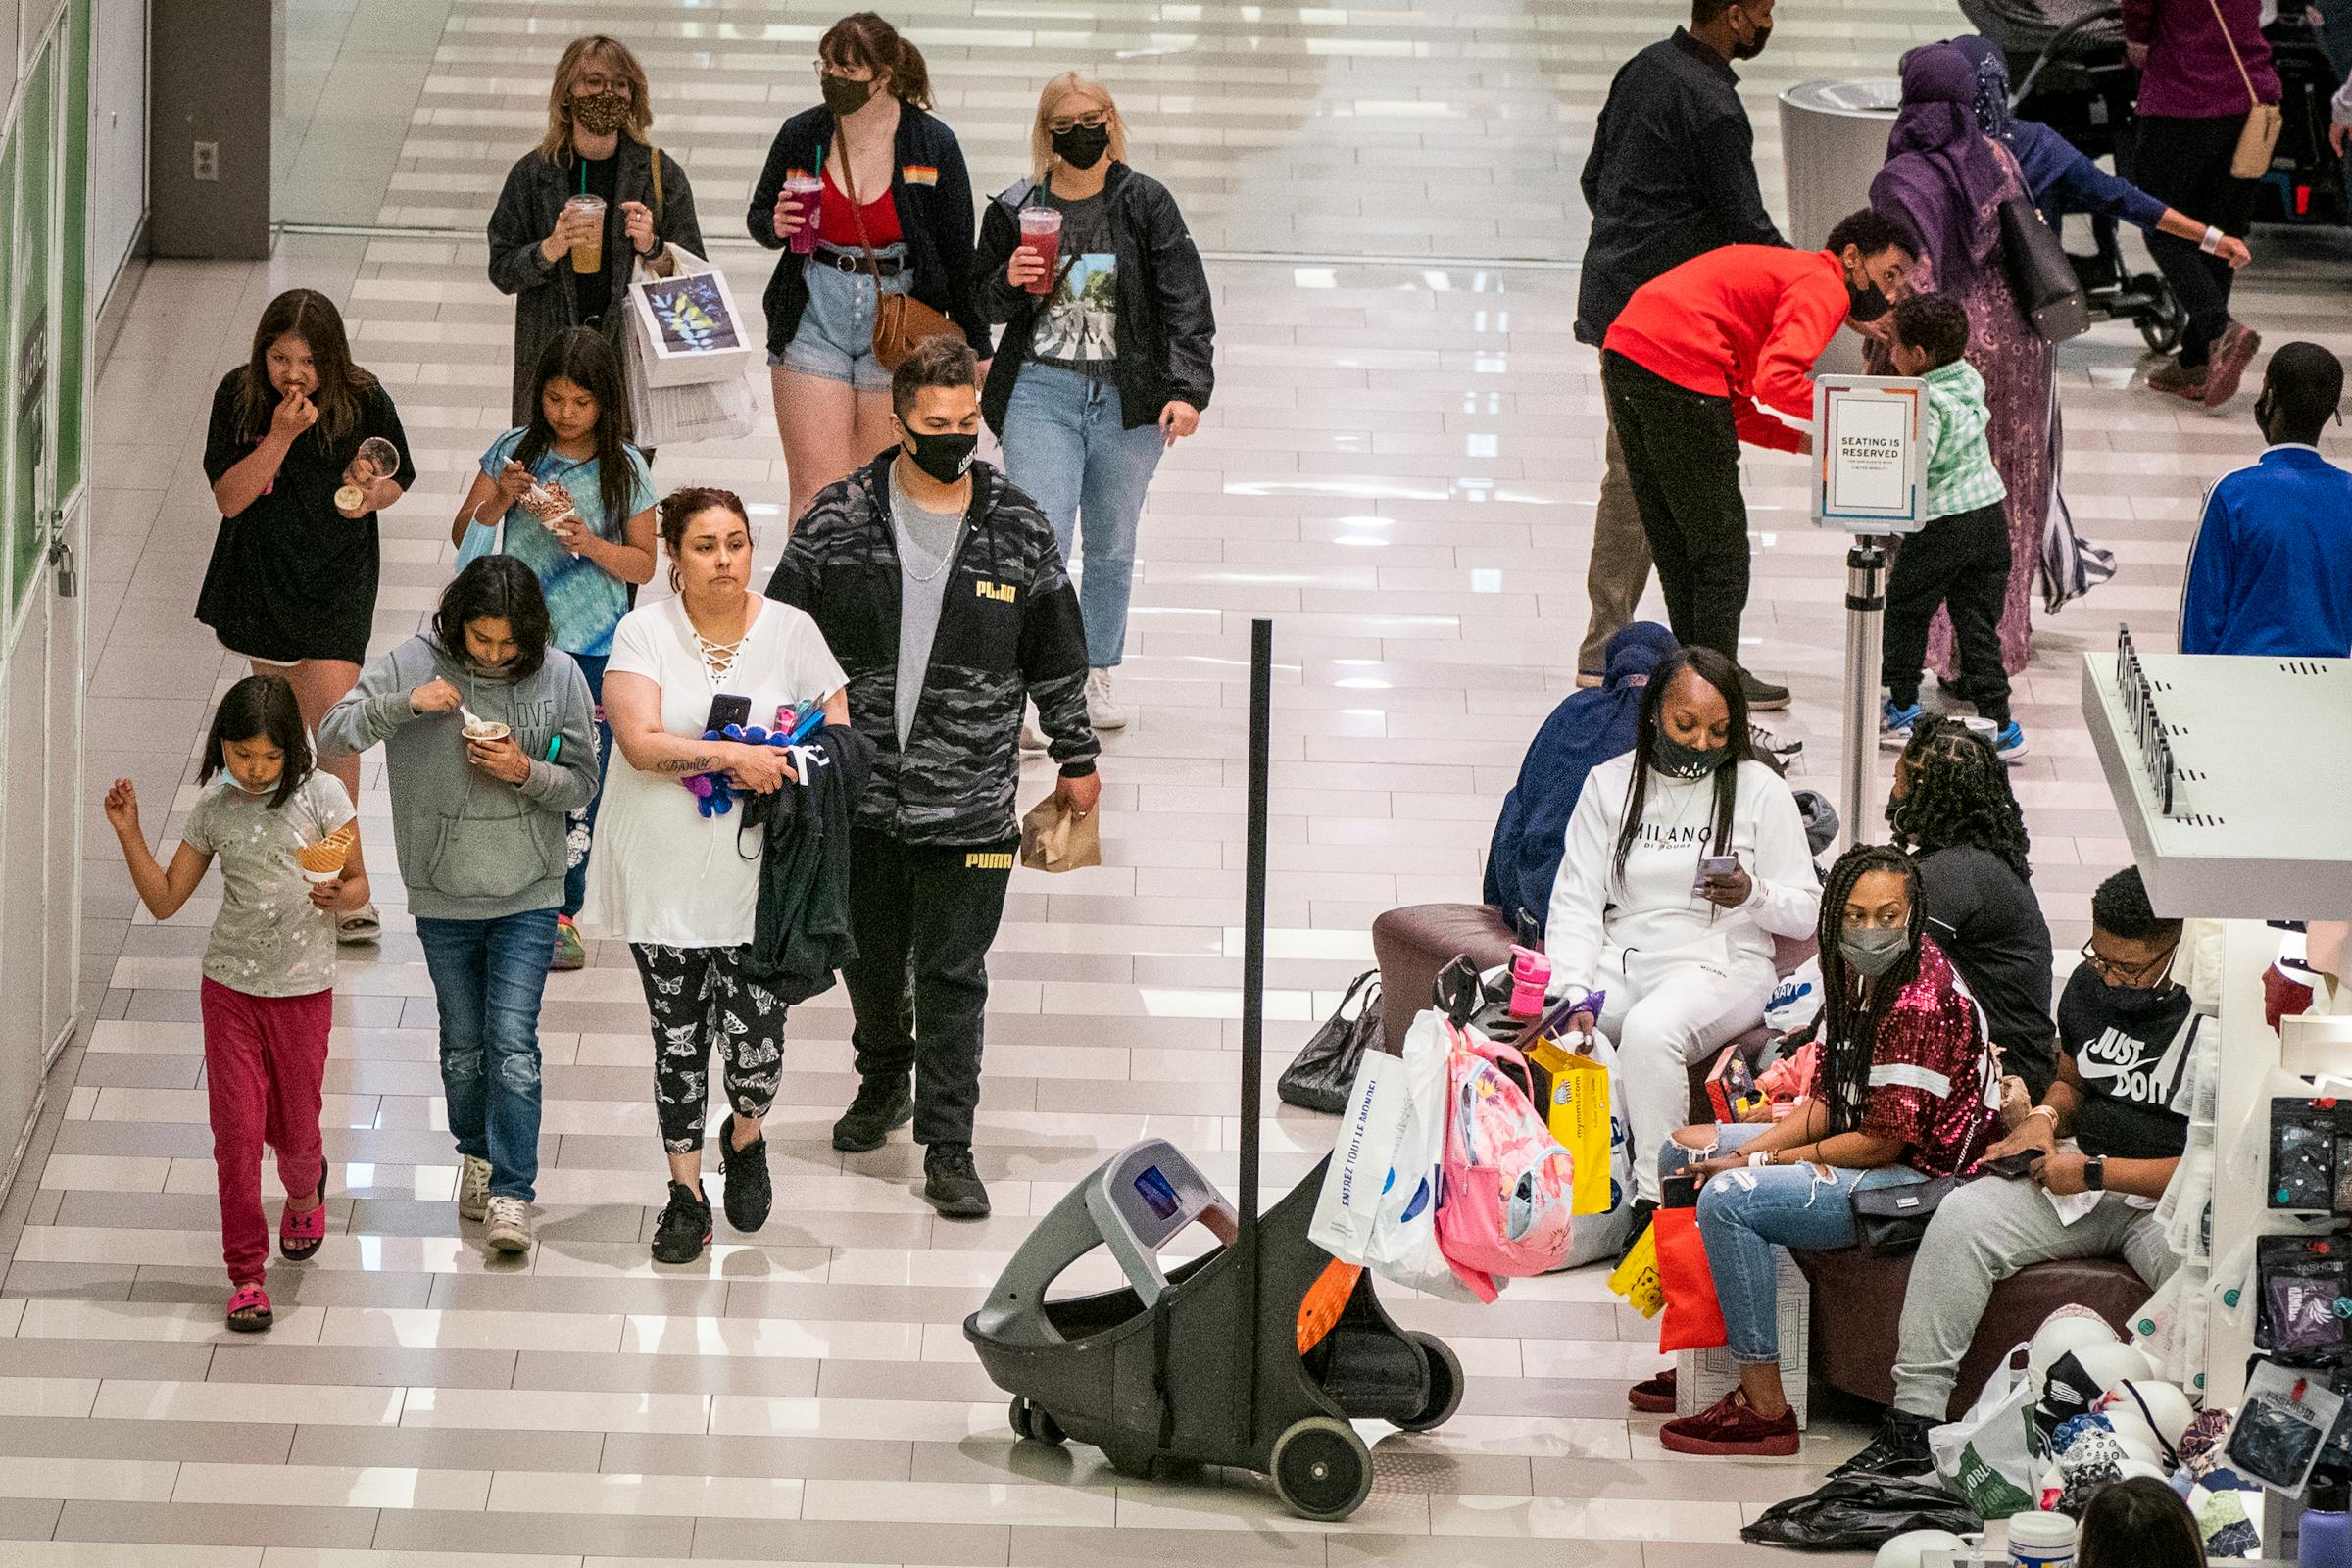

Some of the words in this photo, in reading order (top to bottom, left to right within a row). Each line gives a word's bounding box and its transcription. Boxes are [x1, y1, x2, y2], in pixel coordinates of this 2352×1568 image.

[1842, 437, 1886, 447] SEATING
[1889, 438, 1900, 447] IS
[1842, 448, 1898, 458] RESERVED
[976, 580, 1016, 604] PUMA
[505, 699, 553, 728] LOVE
[965, 853, 1013, 869] PUMA
[2088, 1025, 2146, 1068] JUST
[2109, 1071, 2148, 1102] DO
[1574, 1076, 1585, 1138] mymms.com
[1342, 1166, 1354, 1207] ENTREZ
[1348, 1138, 1362, 1166] TOUT
[1355, 1123, 1365, 1138] LE
